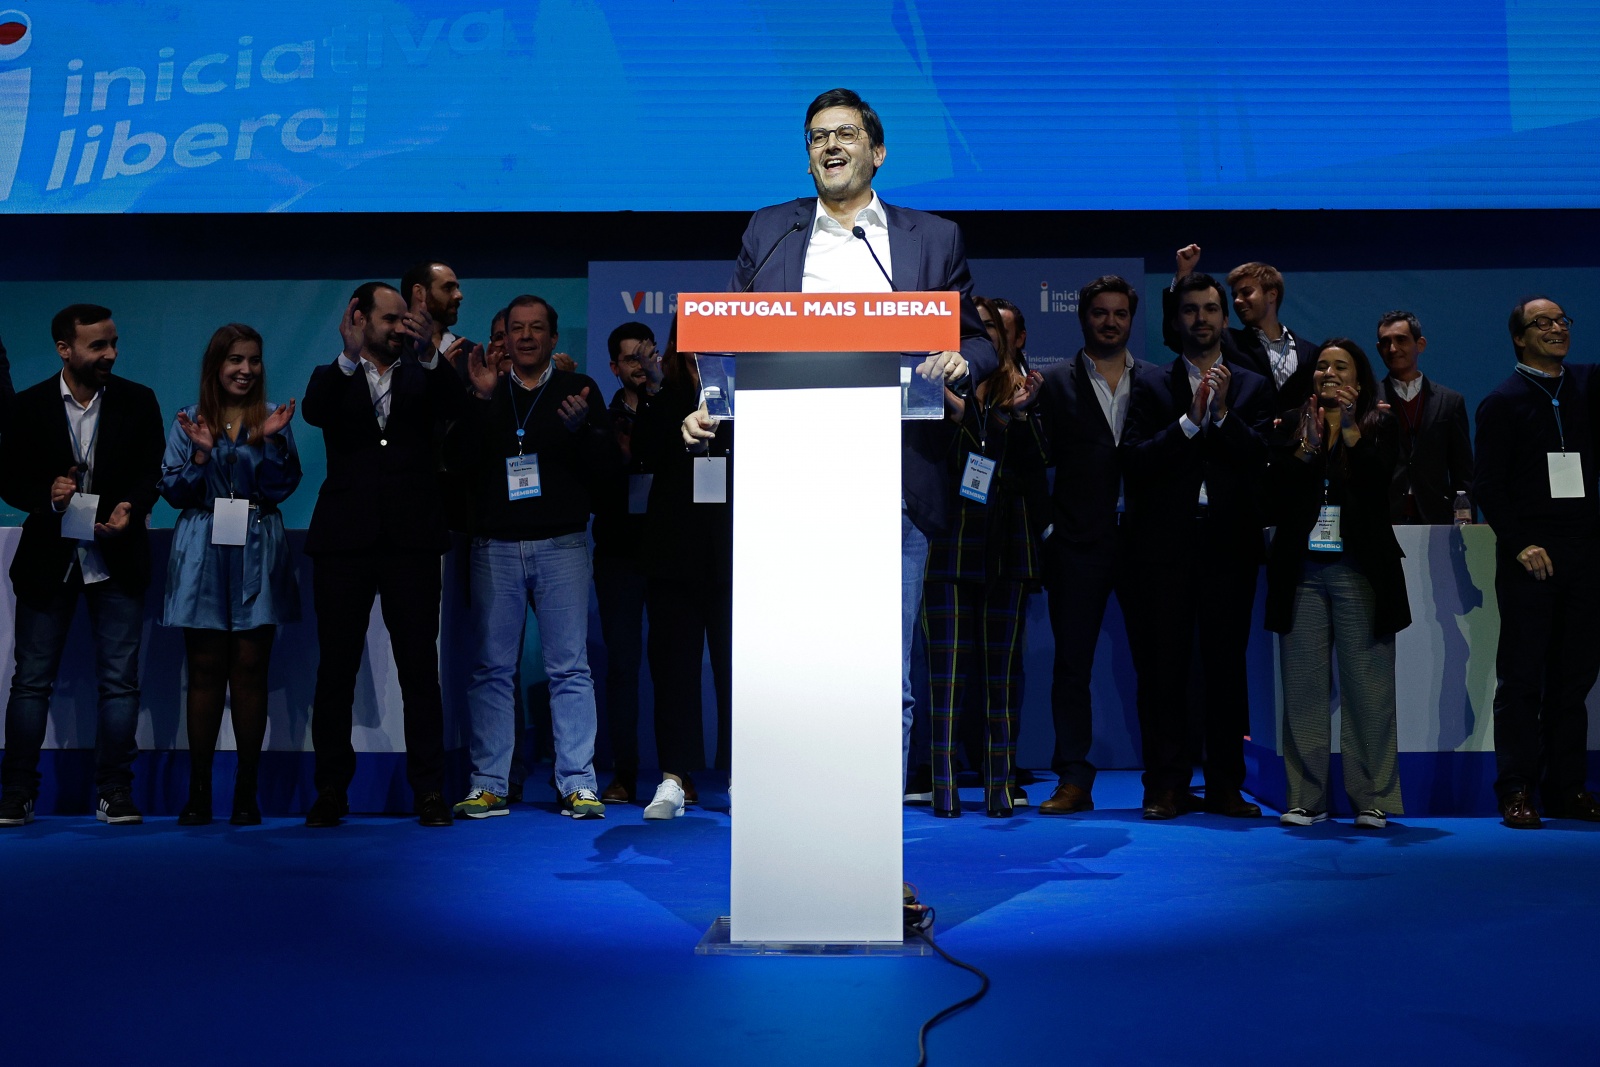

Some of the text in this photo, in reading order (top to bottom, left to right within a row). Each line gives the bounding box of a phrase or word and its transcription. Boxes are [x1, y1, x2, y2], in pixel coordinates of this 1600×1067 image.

[46, 83, 368, 191] liberal
[620, 291, 664, 314] VII
[684, 301, 797, 317] PORTUGAL
[803, 301, 857, 316] MAIS
[863, 300, 952, 316] LIBERAL
